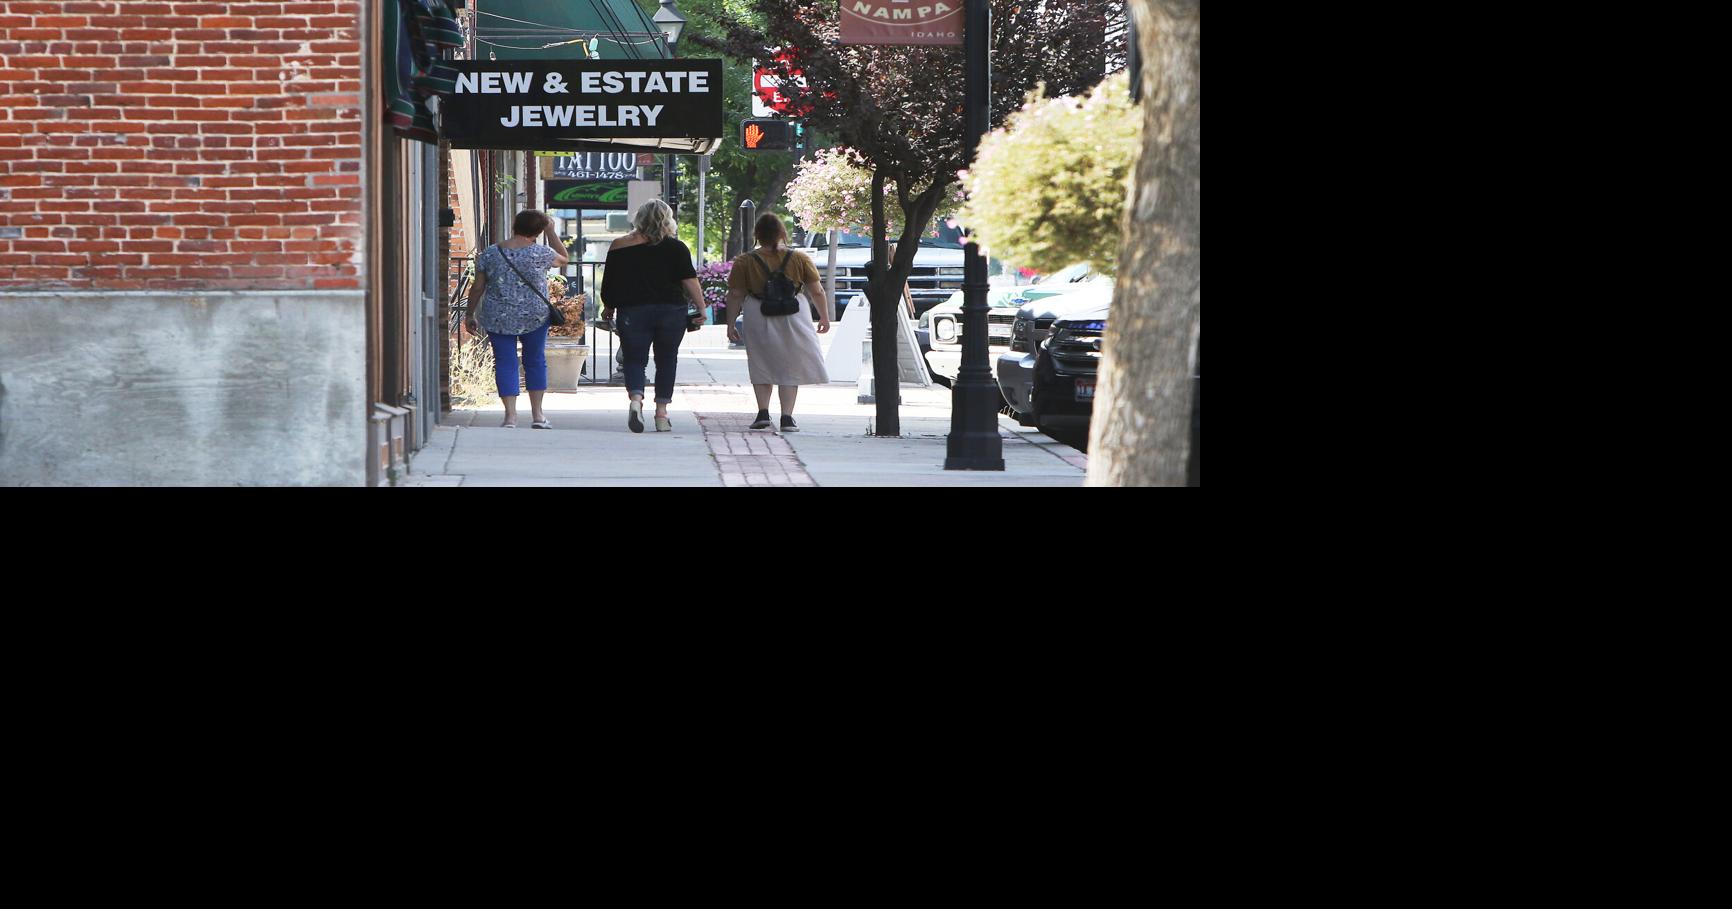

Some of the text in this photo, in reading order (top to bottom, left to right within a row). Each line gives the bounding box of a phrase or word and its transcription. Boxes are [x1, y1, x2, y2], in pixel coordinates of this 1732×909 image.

[852, 1, 951, 20] NAMPA
[455, 71, 709, 94] NEW & ESTATE
[500, 104, 664, 127] JEWELRY
[567, 170, 624, 180] 461-1478
